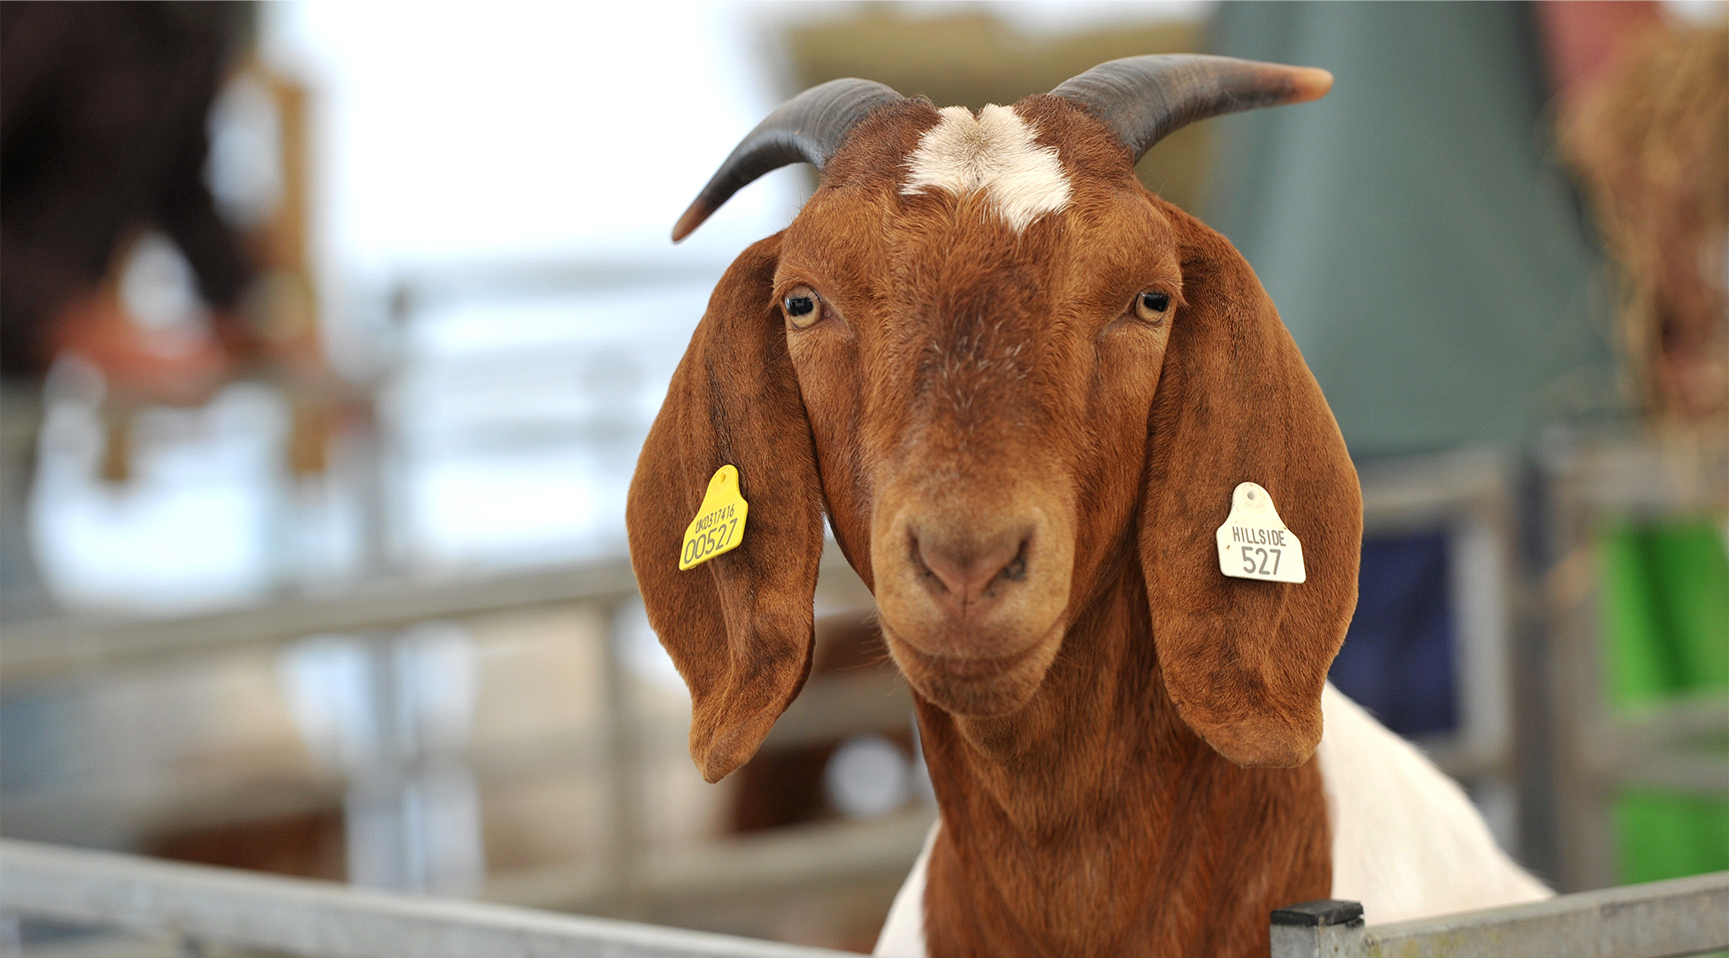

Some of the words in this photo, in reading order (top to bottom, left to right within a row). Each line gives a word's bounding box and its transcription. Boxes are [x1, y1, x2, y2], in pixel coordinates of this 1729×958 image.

[684, 517, 738, 564] 00527
[1232, 526, 1286, 547] HILLSIDE
[1241, 546, 1281, 575] 527
